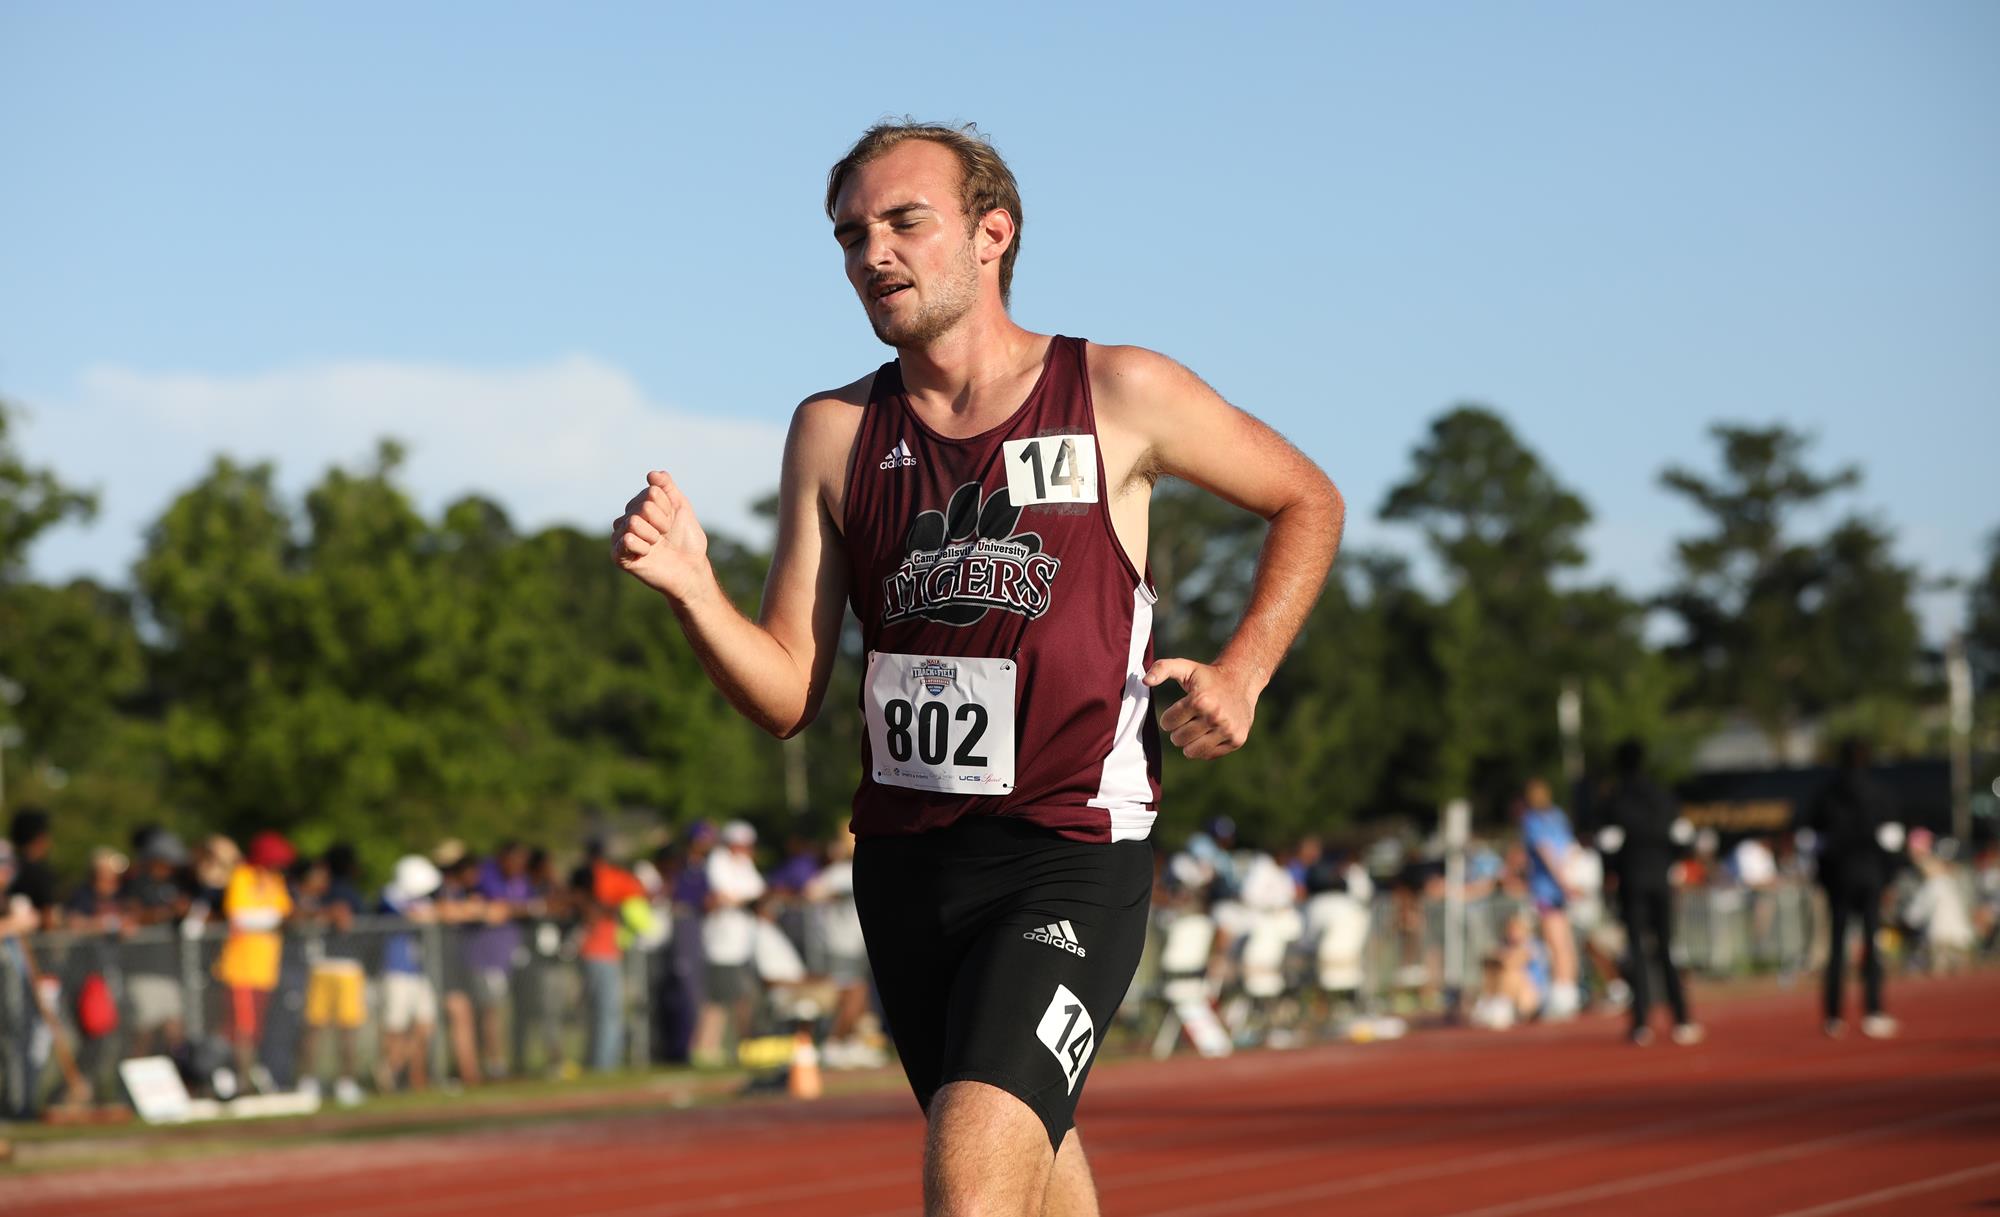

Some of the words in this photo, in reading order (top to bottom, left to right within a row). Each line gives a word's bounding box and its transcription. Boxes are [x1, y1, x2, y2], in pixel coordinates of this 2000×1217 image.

[880, 456, 917, 470] adidas
[1019, 438, 1085, 500] 14
[977, 541, 1027, 559] University
[884, 555, 1057, 620] TIGERS
[884, 699, 989, 767] 802
[1023, 931, 1086, 958] adidas
[1055, 1003, 1092, 1079] 14
